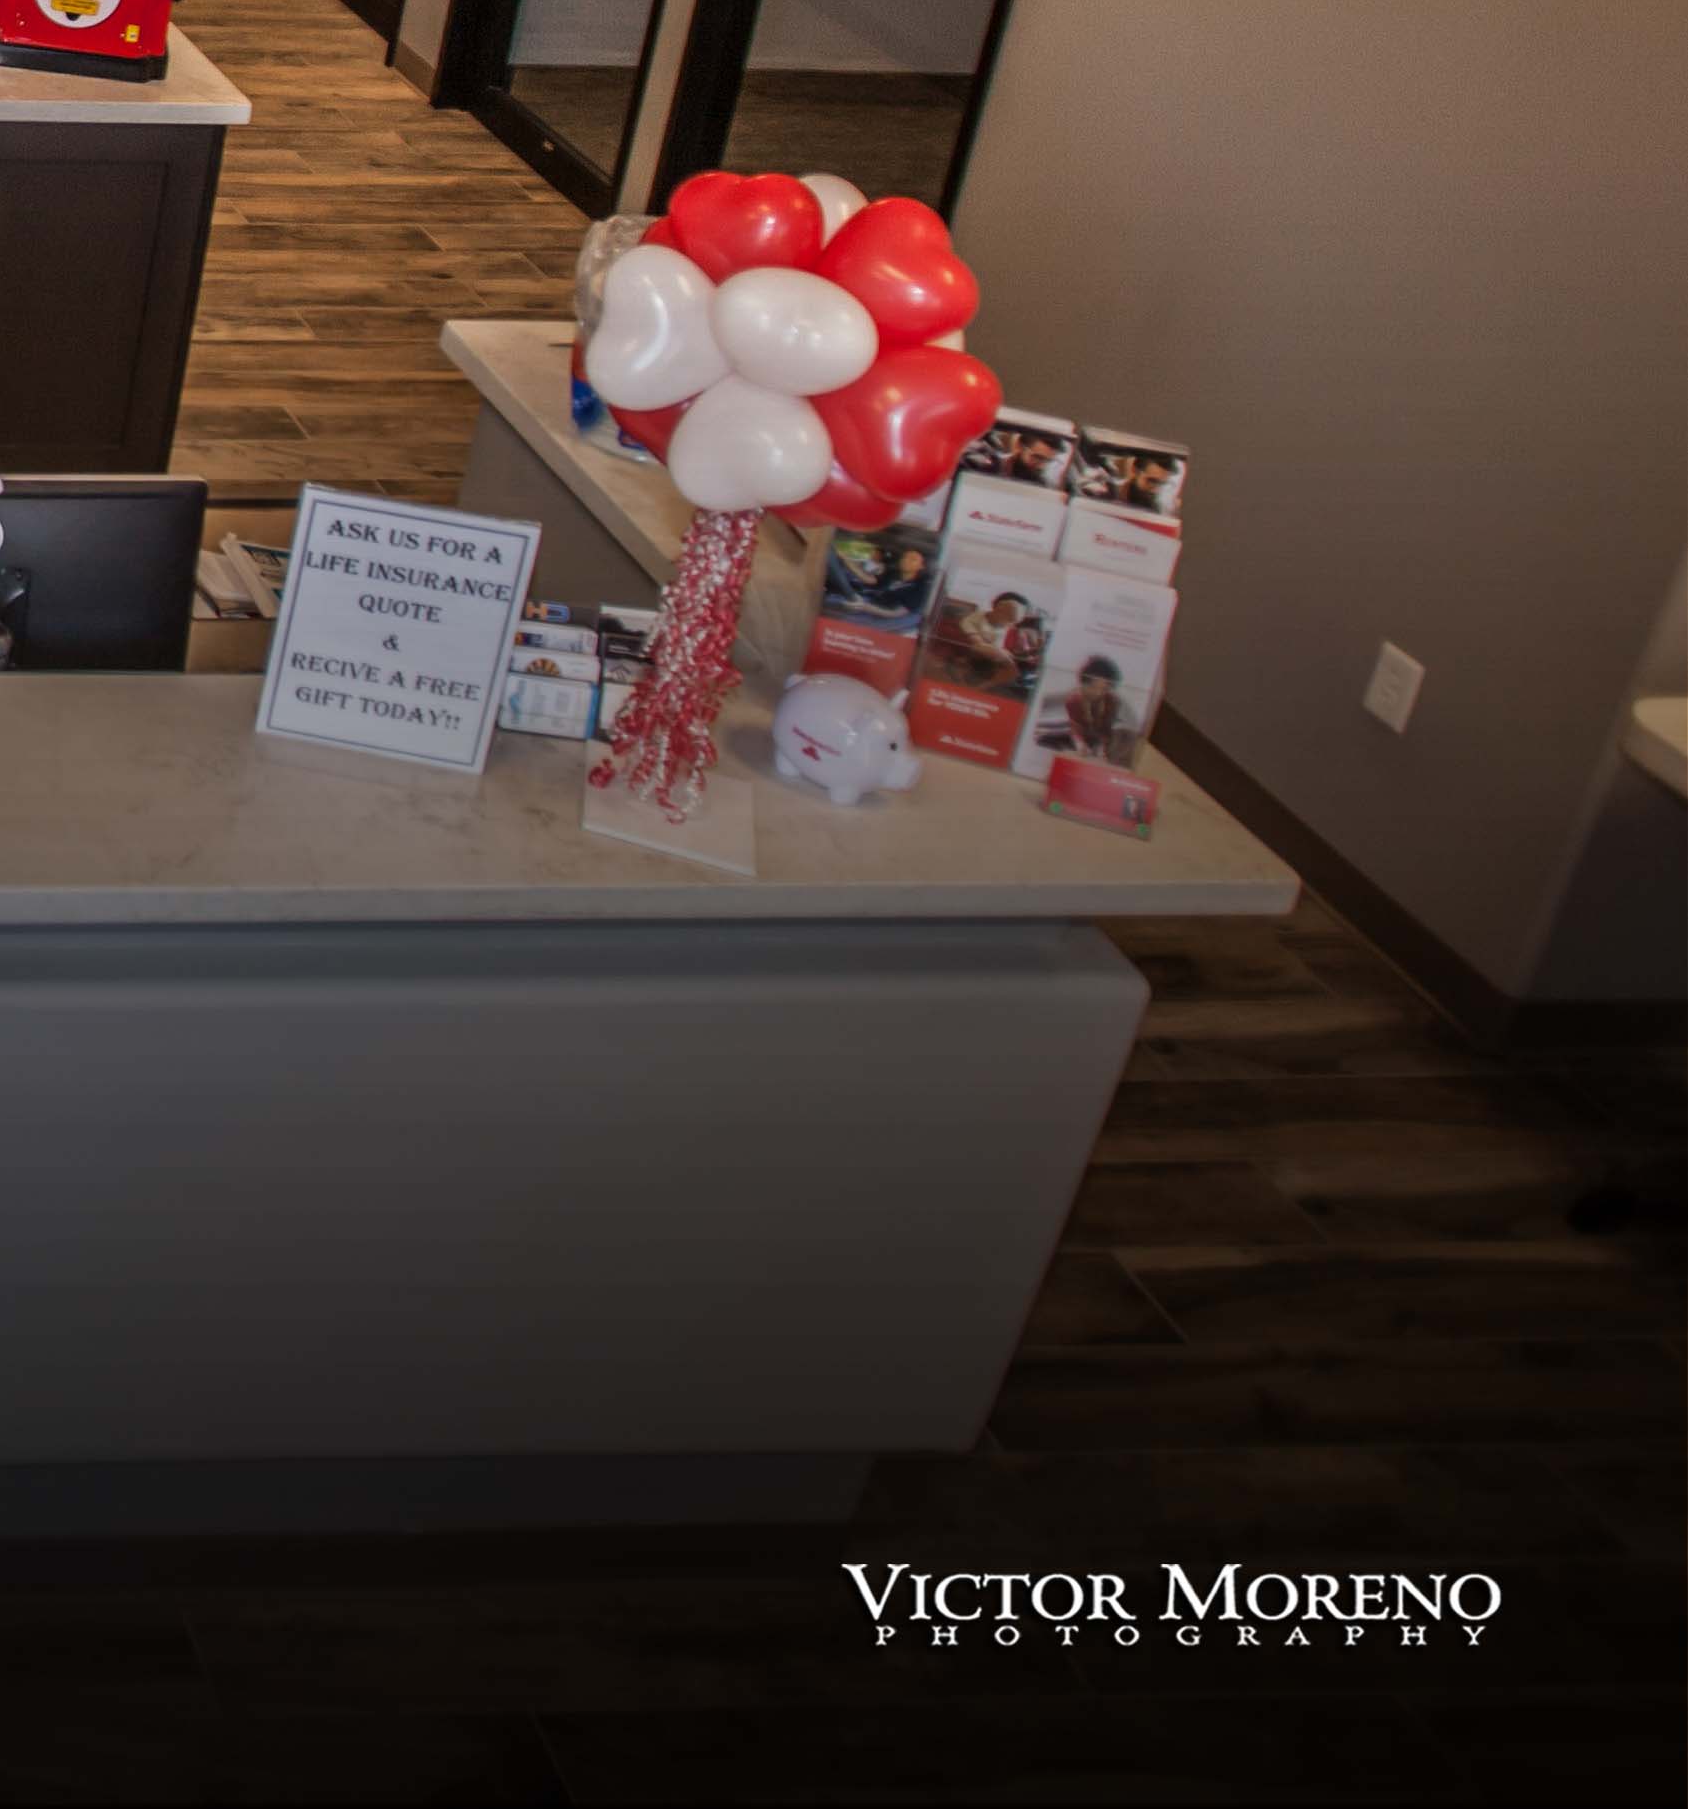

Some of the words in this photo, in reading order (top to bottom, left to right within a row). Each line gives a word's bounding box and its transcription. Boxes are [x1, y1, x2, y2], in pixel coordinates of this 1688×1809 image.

[327, 519, 381, 544] ASK
[388, 528, 420, 549] US
[426, 537, 477, 562] FOR
[483, 545, 503, 566] A
[305, 550, 360, 576] LIFE
[366, 561, 511, 602] INSURANCE
[358, 593, 443, 624] QUOTE
[382, 634, 400, 652] &
[290, 652, 381, 685] RECIVE
[387, 670, 407, 689] A
[413, 675, 481, 702] FREE
[295, 686, 353, 711] GIFT
[359, 696, 461, 731] TODAY!!
